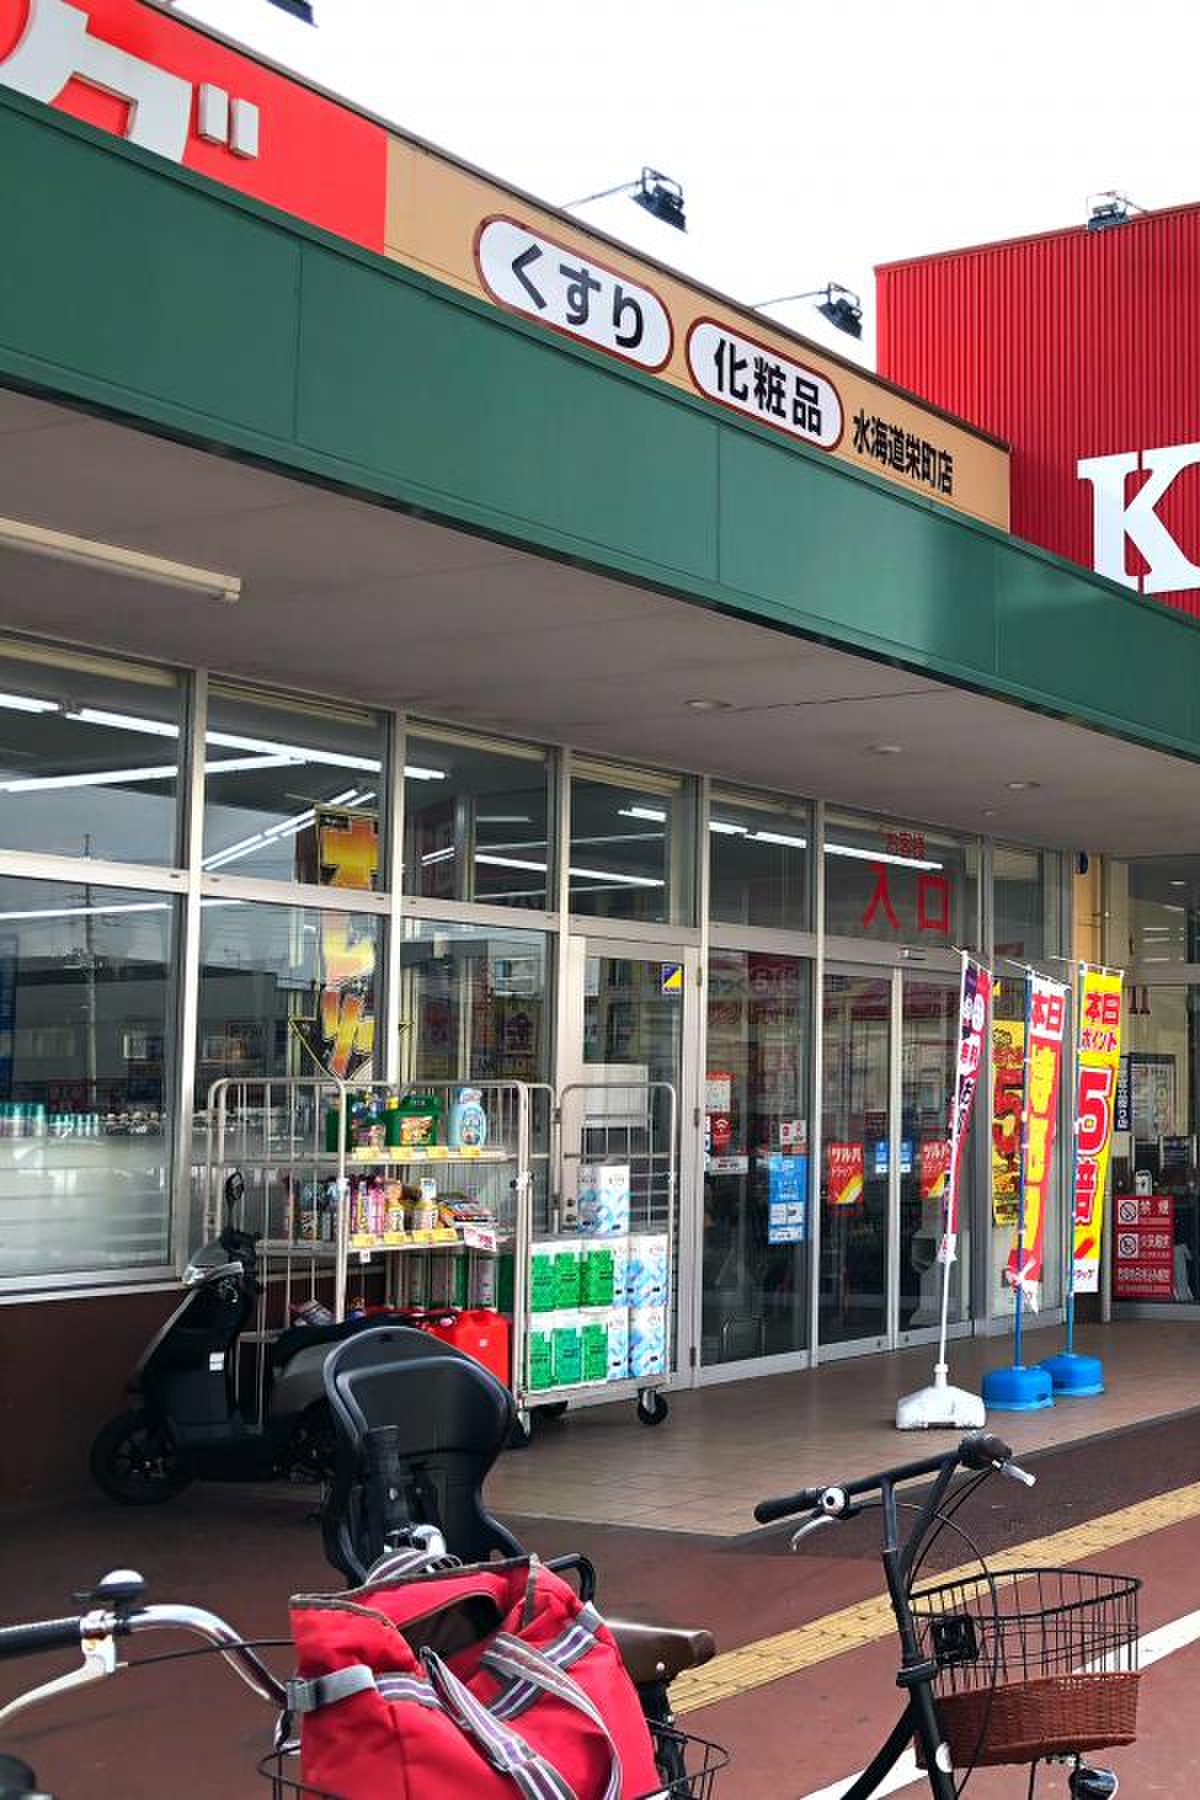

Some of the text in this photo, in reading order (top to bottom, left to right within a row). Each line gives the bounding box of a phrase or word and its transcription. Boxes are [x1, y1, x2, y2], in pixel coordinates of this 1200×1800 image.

[511, 244, 644, 348] くすり
[713, 337, 822, 437] 化粧品
[853, 409, 954, 497] 水海道栄町店
[863, 863, 950, 934] 入口
[1031, 991, 1066, 1034] 本日
[1085, 992, 1121, 1026] 本日
